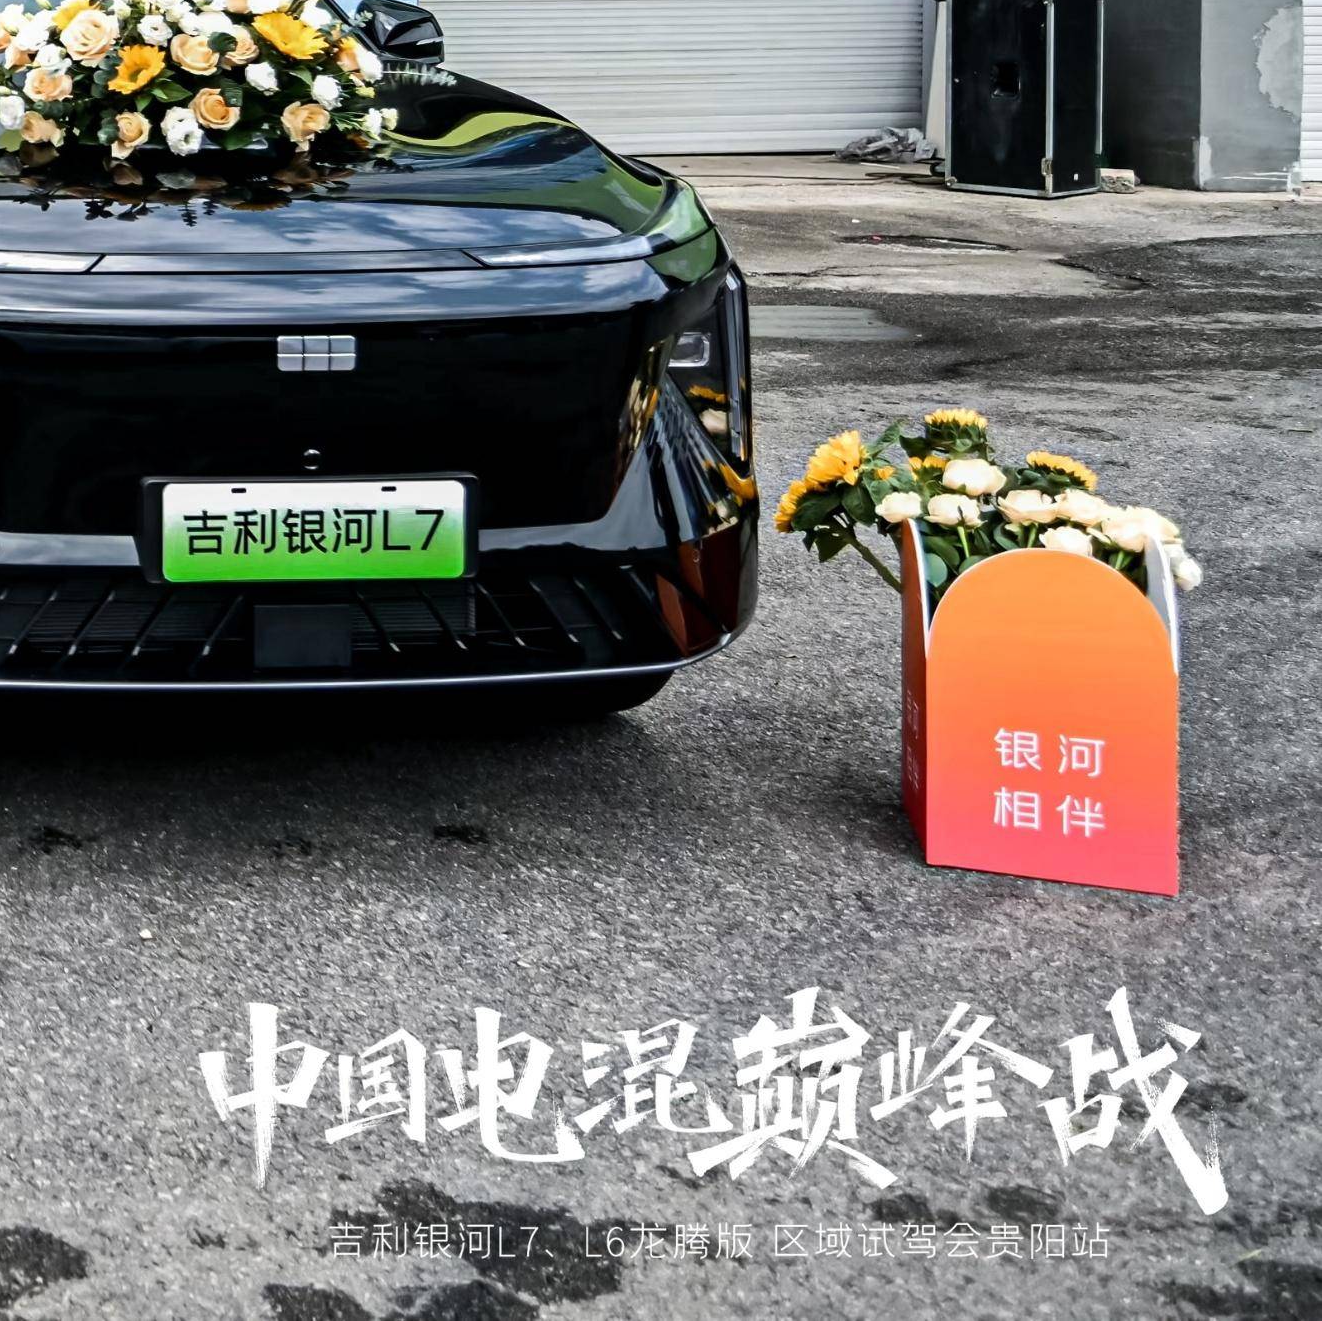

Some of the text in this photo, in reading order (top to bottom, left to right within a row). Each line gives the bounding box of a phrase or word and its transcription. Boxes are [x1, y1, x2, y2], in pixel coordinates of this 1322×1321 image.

[183, 508, 445, 555] 吉利银河L7
[993, 727, 1106, 779] 银河
[993, 785, 1106, 839] 相伴
